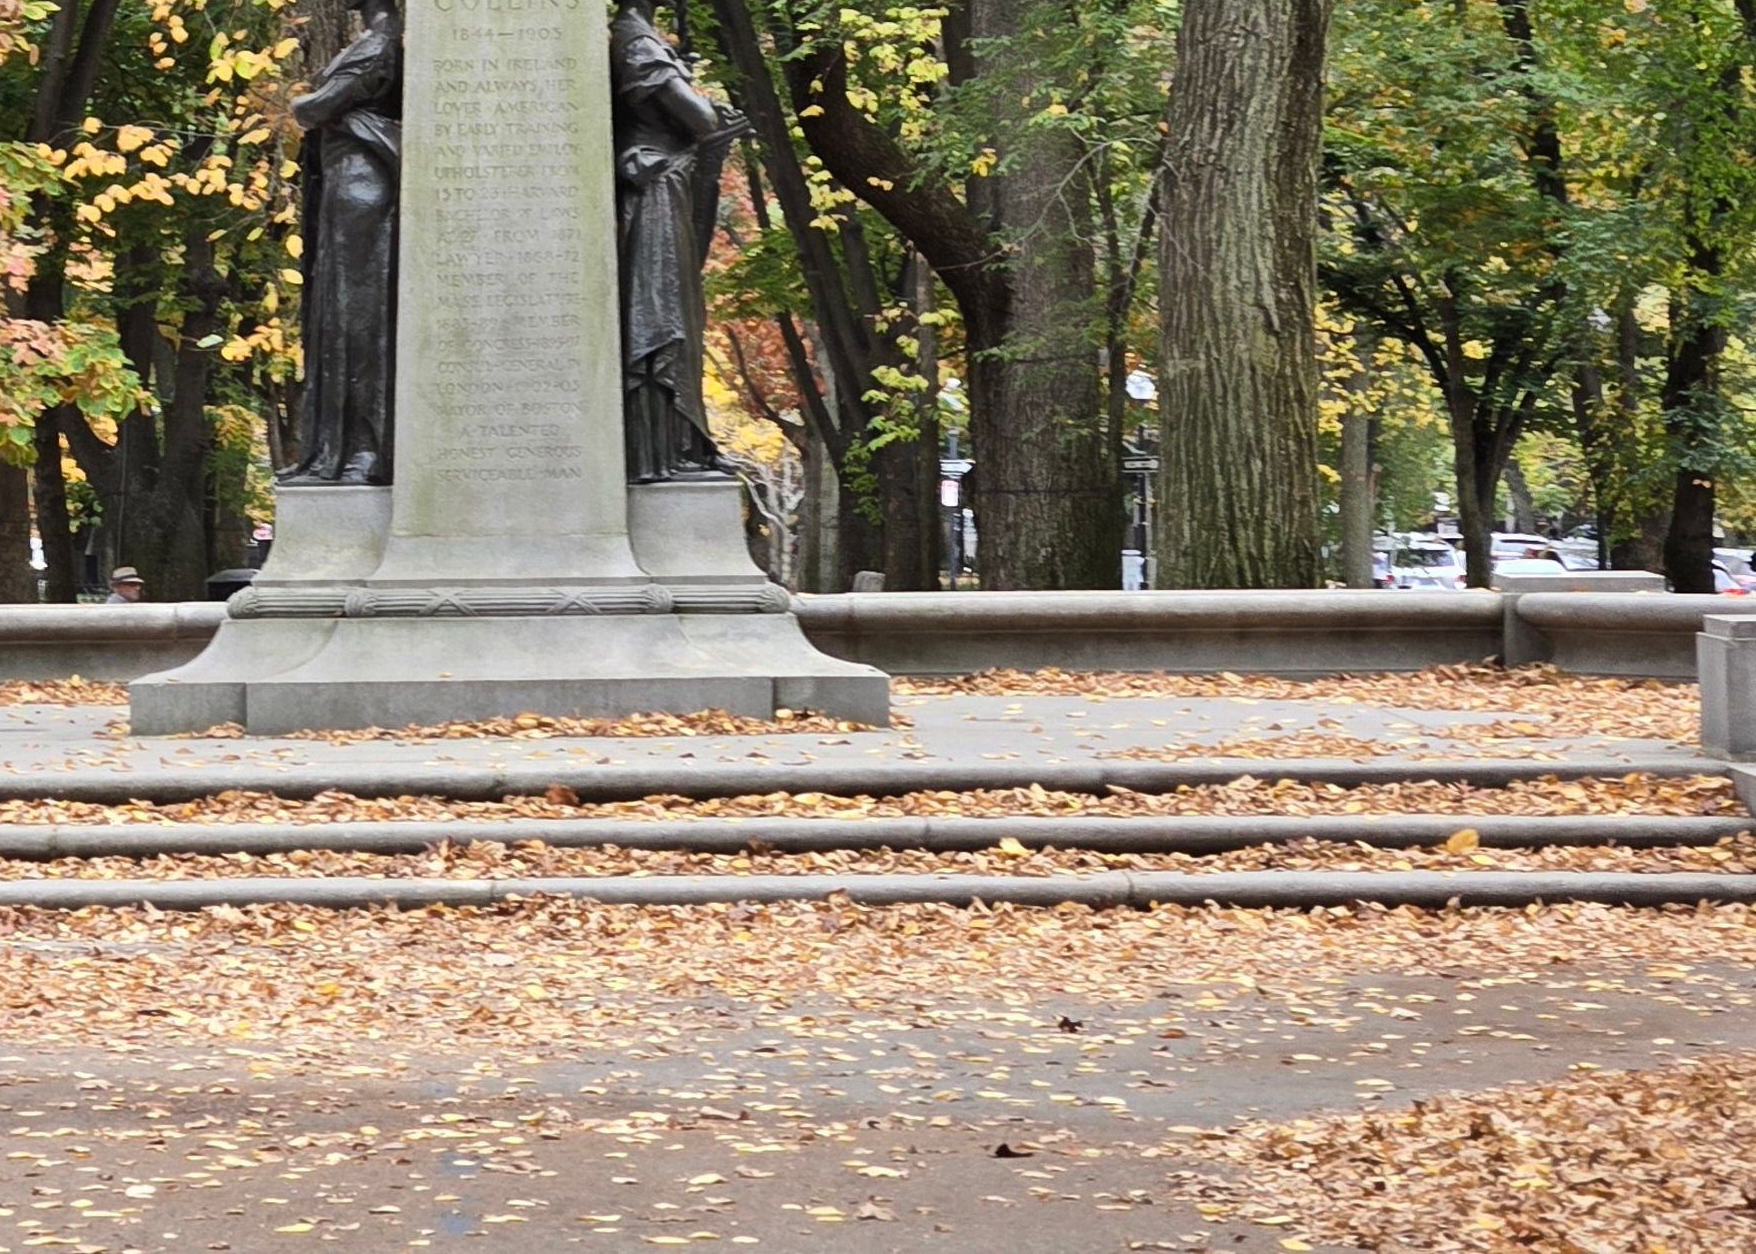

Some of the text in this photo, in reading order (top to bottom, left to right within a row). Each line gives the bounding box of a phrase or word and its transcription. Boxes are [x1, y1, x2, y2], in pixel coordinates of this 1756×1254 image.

[433, 56, 577, 73] BORN IN IRELAND
[435, 80, 468, 93] AND
[545, 78, 577, 92] HER
[435, 100, 579, 116] LOVER AMERICAN
[435, 123, 452, 137] BY
[457, 123, 496, 136] EARLY
[435, 145, 466, 157] AND
[453, 187, 476, 202] TO
[494, 229, 540, 244] FROM
[517, 272, 537, 286] OF
[547, 271, 580, 284] THE
[544, 466, 582, 480] MAN
